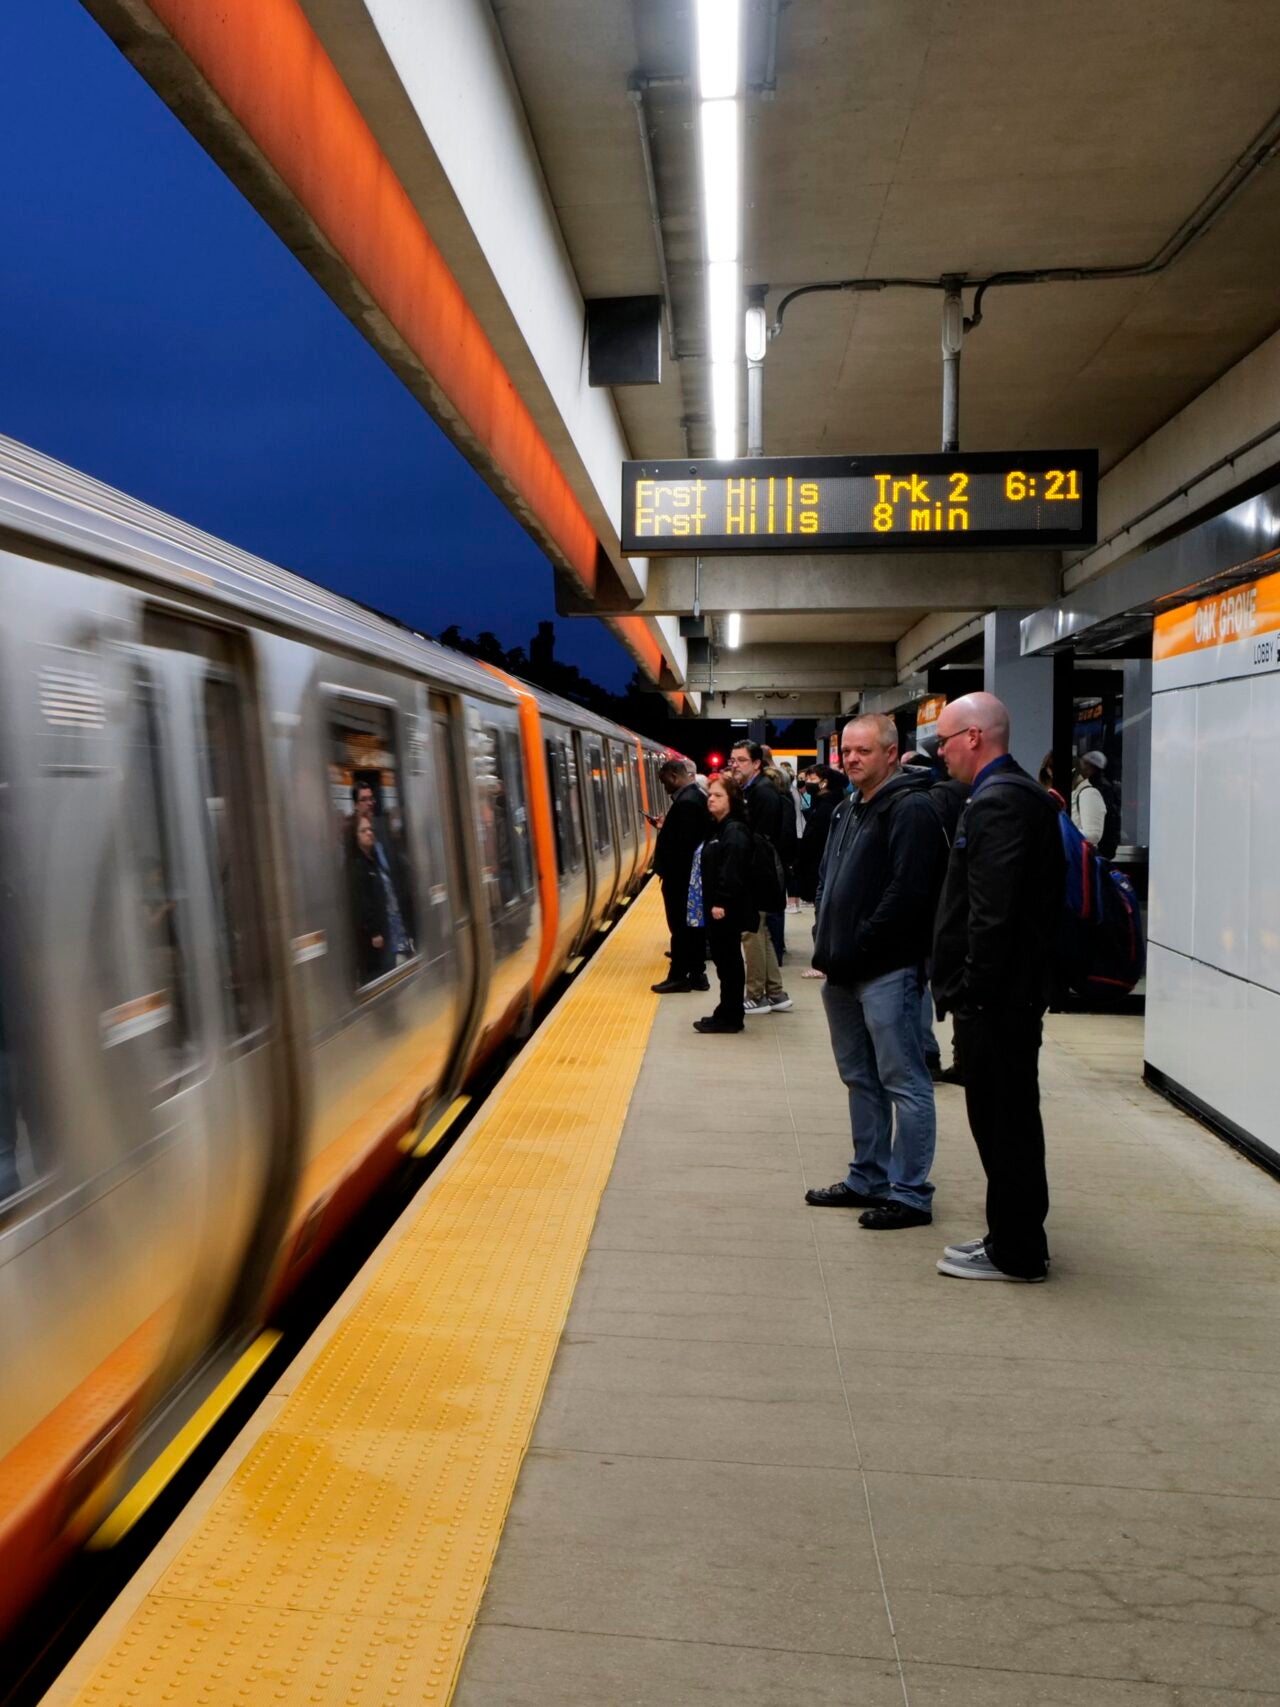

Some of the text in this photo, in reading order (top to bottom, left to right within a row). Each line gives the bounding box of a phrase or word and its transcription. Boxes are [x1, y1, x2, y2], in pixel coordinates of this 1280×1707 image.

[635, 469, 1080, 508] Frst Hills Trk 2 6:21
[634, 501, 969, 537] Frst Hills 8 min
[1194, 588, 1257, 643] OAK GROVE
[1253, 641, 1274, 665] LOBBY
